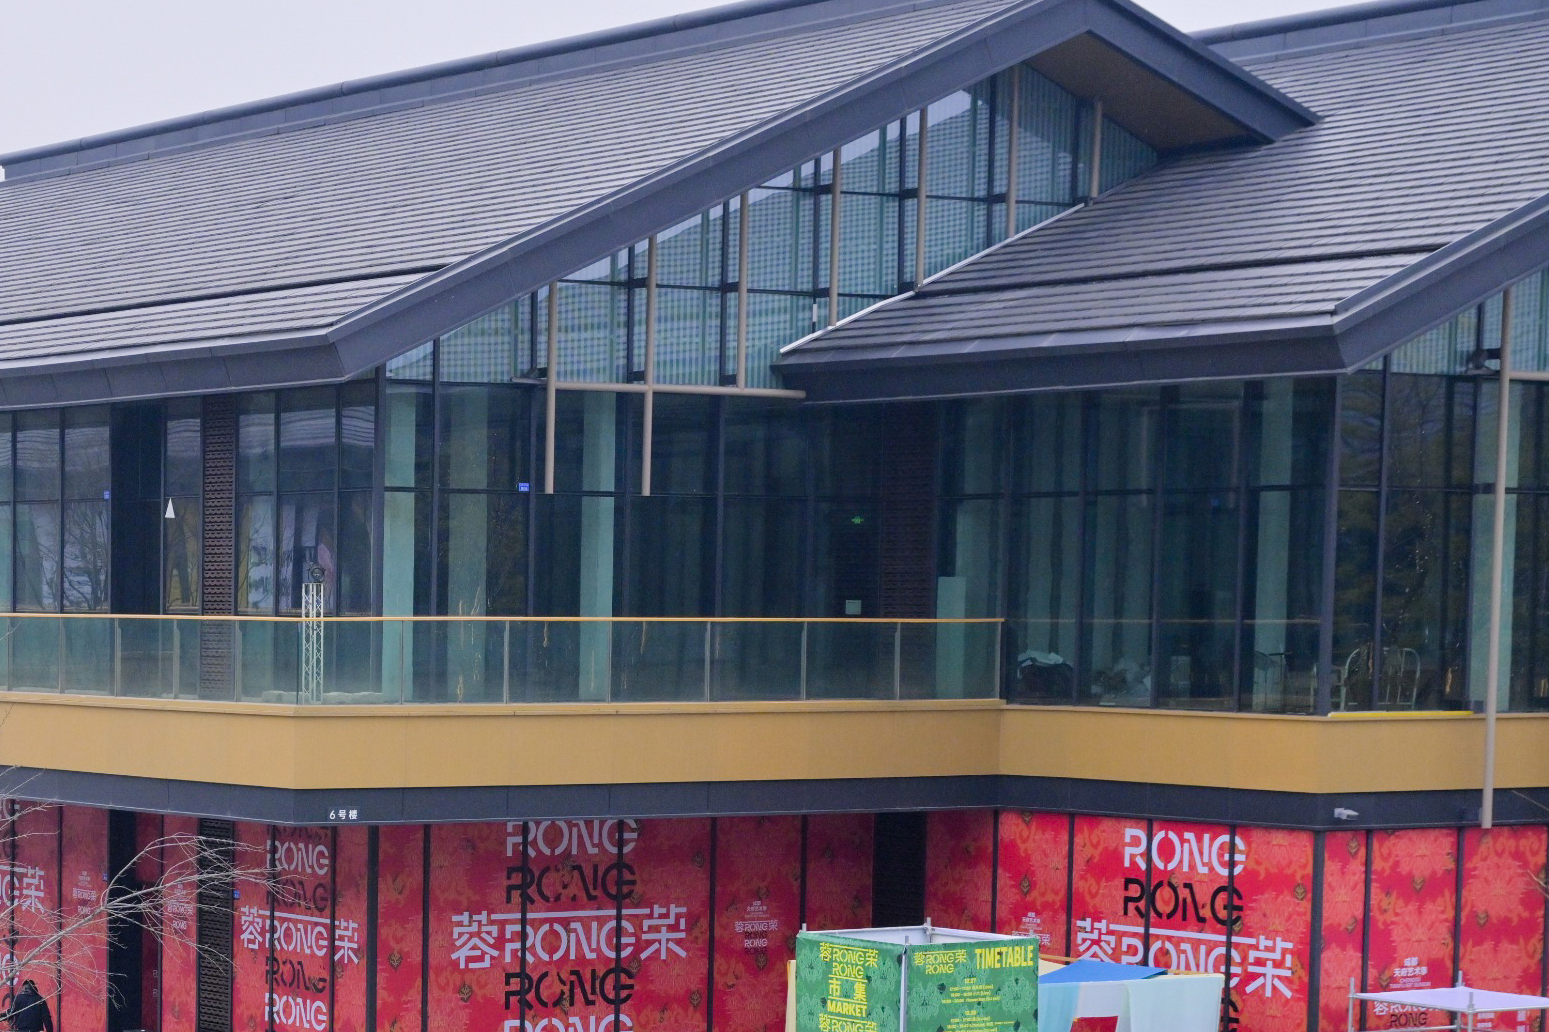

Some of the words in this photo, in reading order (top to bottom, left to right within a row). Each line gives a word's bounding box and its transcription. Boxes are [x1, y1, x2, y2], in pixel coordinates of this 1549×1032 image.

[330, 810, 358, 820] 6号楼
[506, 819, 638, 858] RONG
[266, 839, 329, 876] RONG
[1124, 828, 1246, 875] RONG
[506, 863, 637, 905] RONG
[1123, 877, 1243, 926] RONG
[744, 939, 768, 947] RONG
[975, 945, 1034, 969] TIMETABLE
[1404, 957, 1418, 966] 成都
[832, 962, 864, 978] RONG
[926, 964, 954, 974] RONG
[1394, 966, 1427, 977] 天府艺术季
[504, 967, 634, 1010] RONG
[264, 992, 327, 1031] RONG
[827, 1000, 867, 1017] MARKET
[1390, 1012, 1427, 1027] RONG
